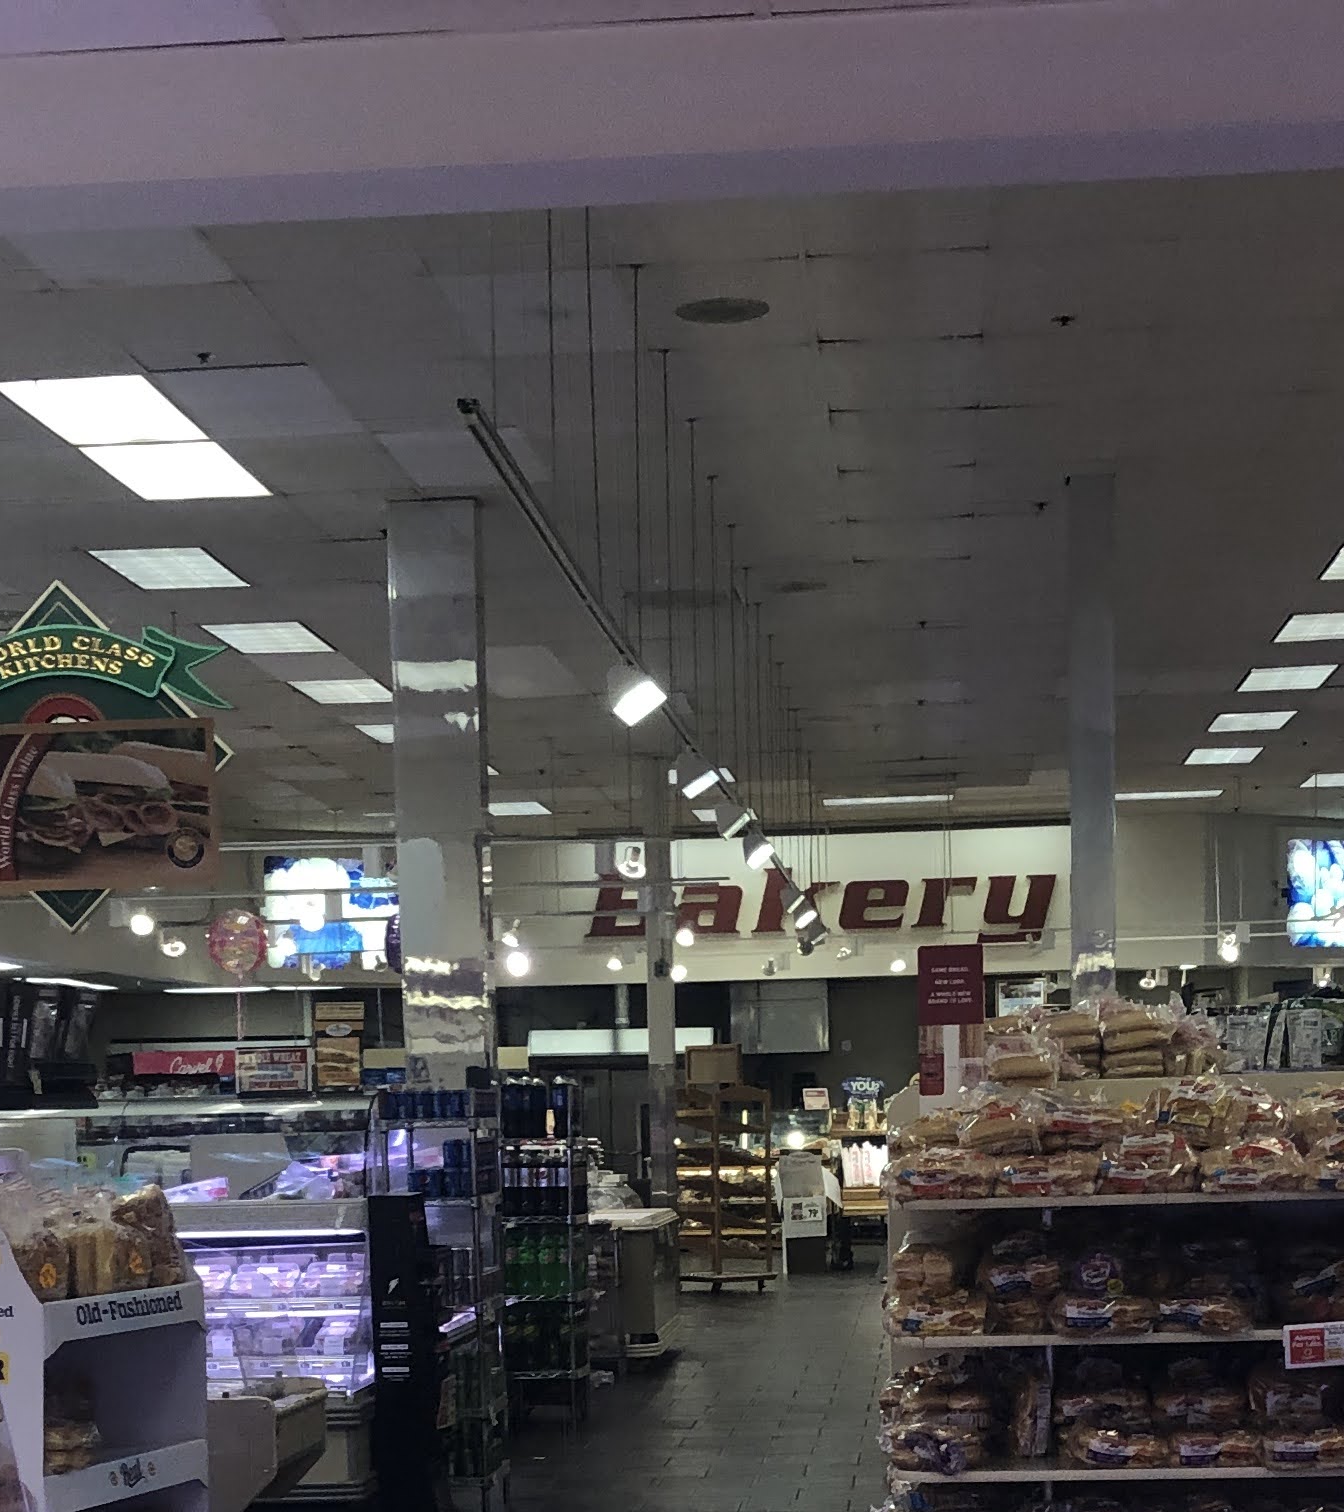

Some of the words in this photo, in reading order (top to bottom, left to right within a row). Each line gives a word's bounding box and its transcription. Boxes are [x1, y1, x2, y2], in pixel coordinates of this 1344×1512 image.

[71, 634, 157, 668] CLASS
[585, 866, 1057, 944] Bakery
[169, 1056, 214, 1075] Carvel
[76, 1290, 183, 1326] Old-Fashioned
